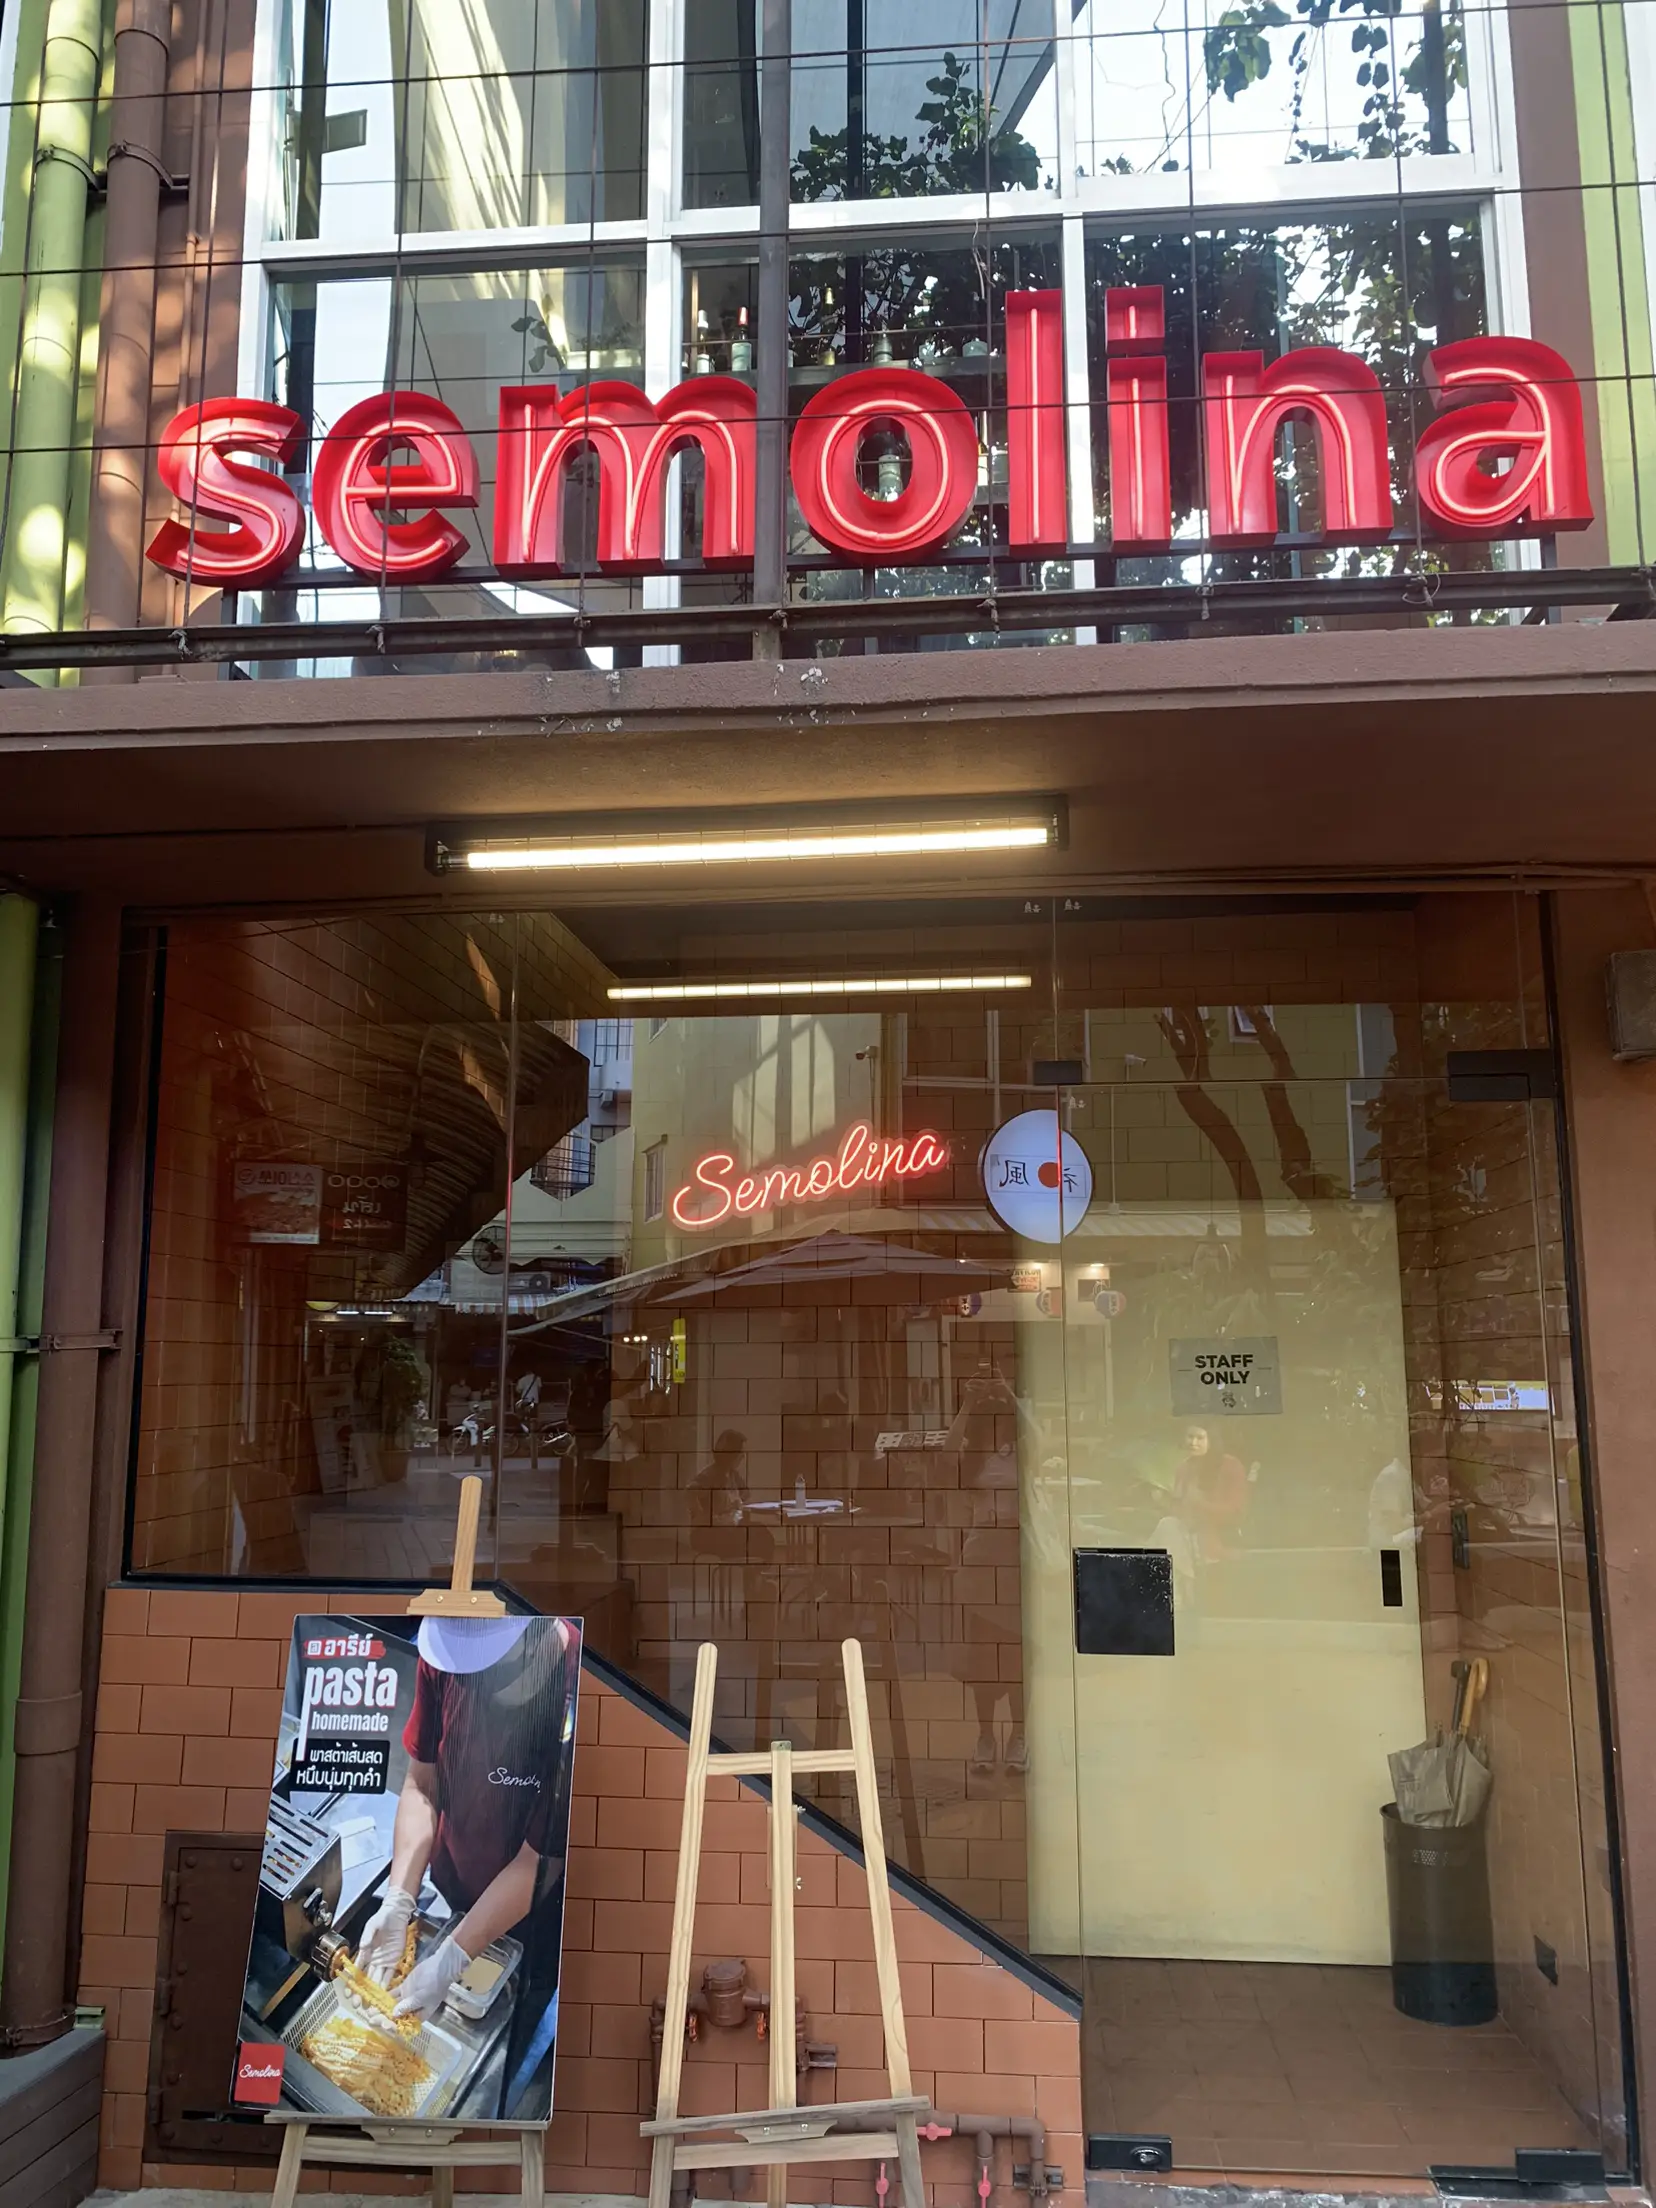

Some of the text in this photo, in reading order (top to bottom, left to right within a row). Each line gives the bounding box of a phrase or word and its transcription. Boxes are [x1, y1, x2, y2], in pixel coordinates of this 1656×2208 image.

[147, 285, 1595, 588] semolina
[672, 1123, 945, 1227] Semolina
[1194, 1354, 1253, 1368] STAFF
[1200, 1371, 1250, 1385] ONLY
[311, 1711, 389, 1732] homemade
[309, 1741, 384, 1764] พาสต้าเส้นสด
[296, 1765, 381, 1792] หนึบนุ่มทุกคำ
